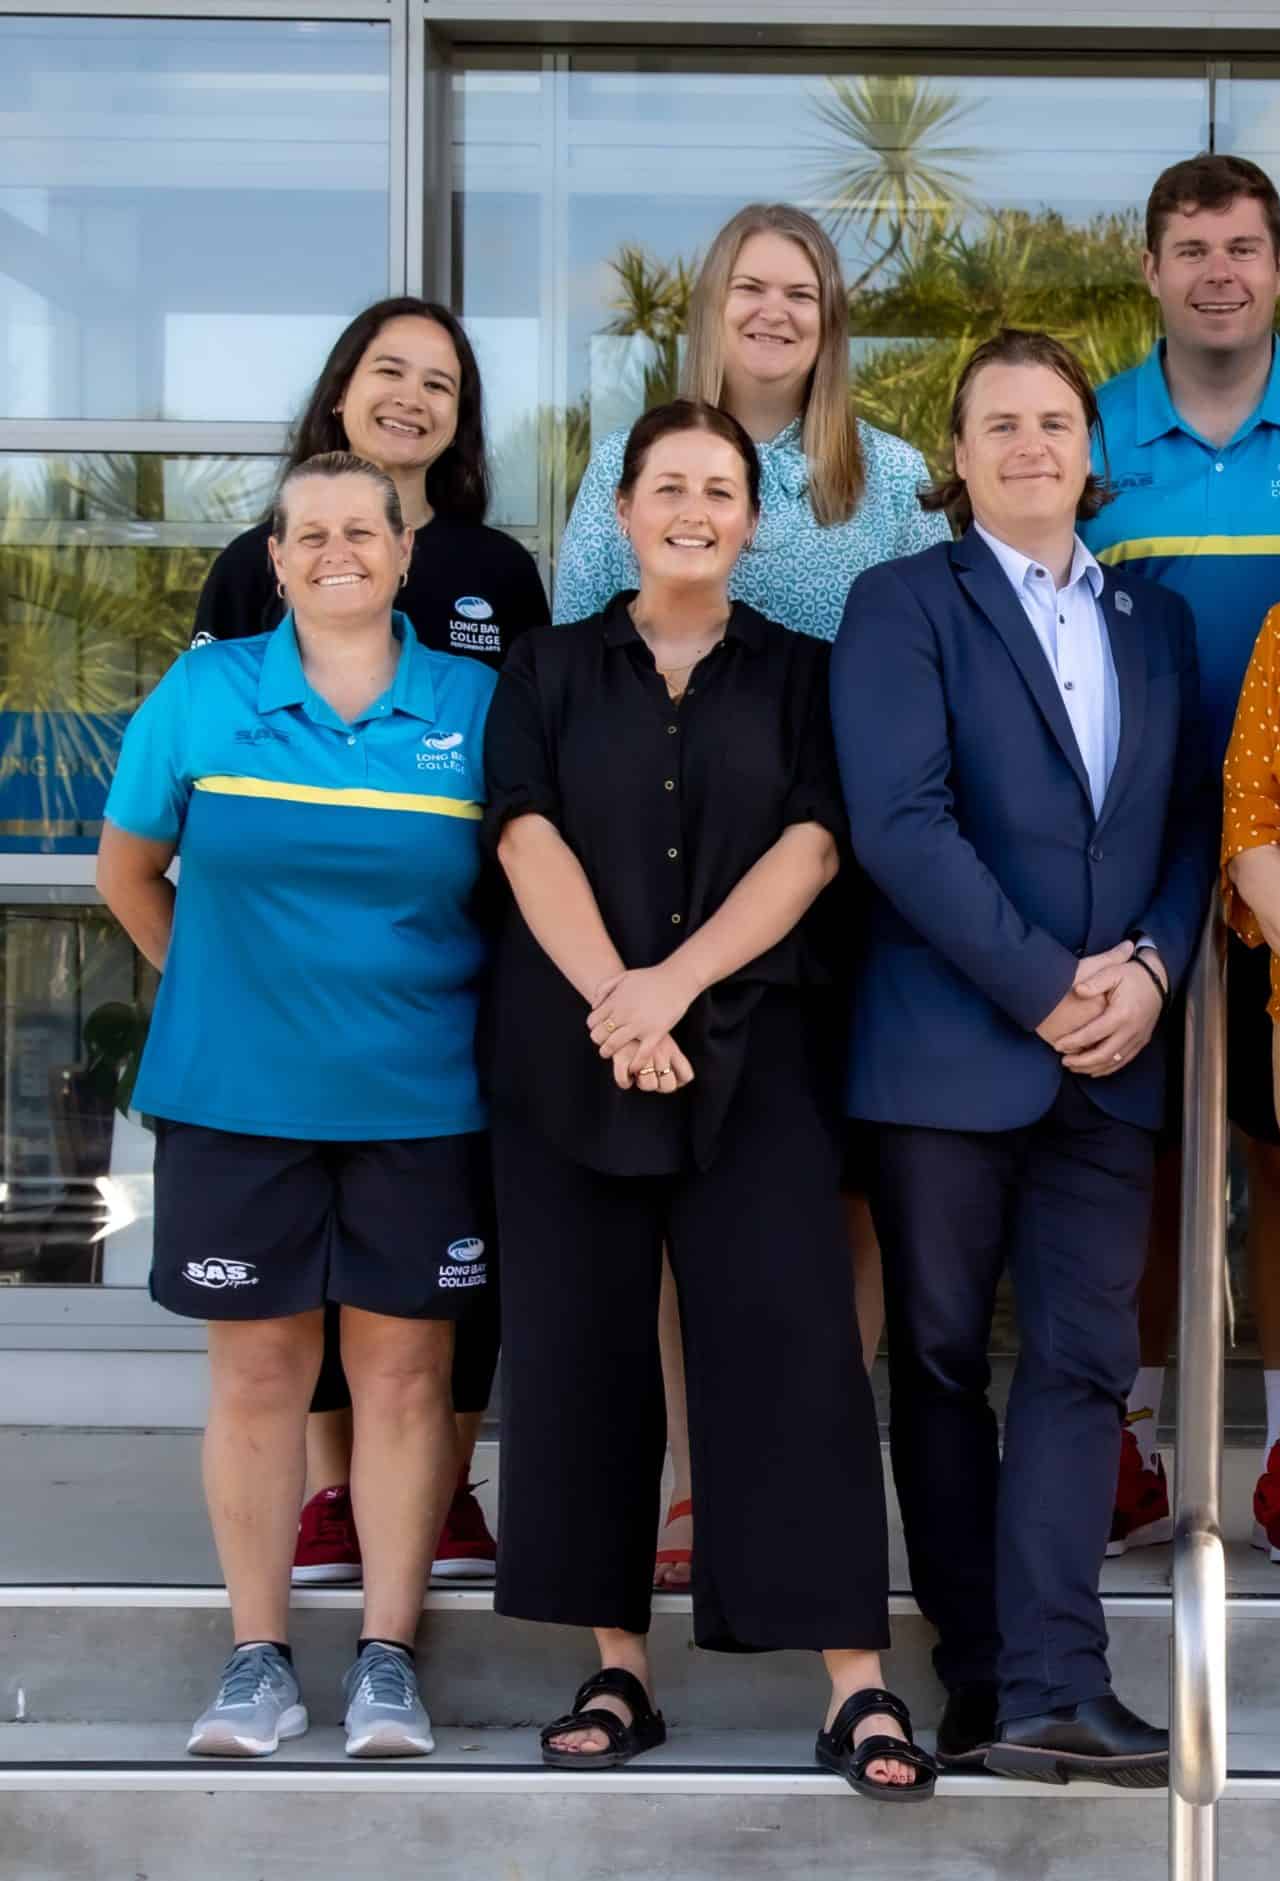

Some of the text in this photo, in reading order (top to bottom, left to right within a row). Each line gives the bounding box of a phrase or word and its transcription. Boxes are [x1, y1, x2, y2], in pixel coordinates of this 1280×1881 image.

[449, 620, 500, 635] LONG BAY
[450, 631, 502, 647] COLLEGE
[416, 752, 449, 762] LONG
[186, 1261, 248, 1281] SAS
[439, 1265, 470, 1276] LONG
[438, 1274, 488, 1288] COLLEGE
